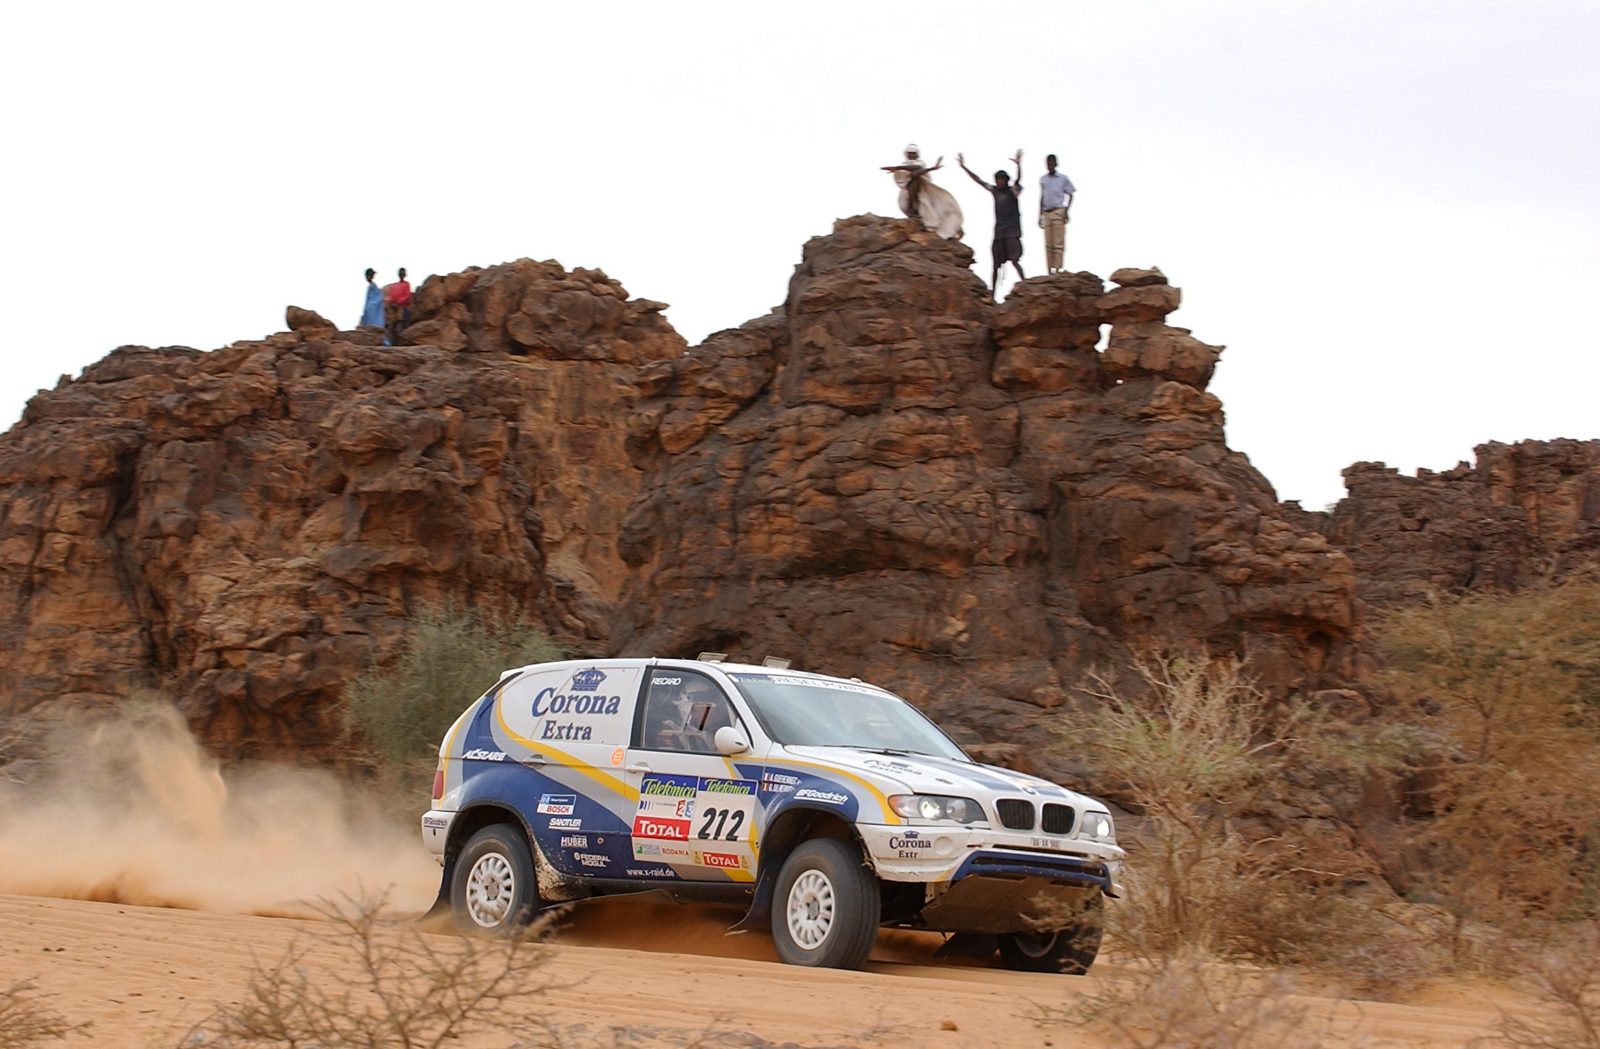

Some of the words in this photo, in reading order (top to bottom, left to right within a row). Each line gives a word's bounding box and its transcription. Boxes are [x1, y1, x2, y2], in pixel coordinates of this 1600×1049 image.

[652, 677, 682, 686] RECARO
[531, 687, 621, 717] Corona
[541, 720, 592, 740] Extra
[796, 788, 848, 803] BFGoodrich
[546, 806, 569, 814] BOSCH
[640, 820, 683, 837] TOTAL
[698, 807, 745, 841] 212
[561, 836, 588, 848] HUBER
[889, 837, 931, 849] Corona
[580, 853, 611, 862] FEDERAL
[662, 847, 689, 856] RODANIA
[704, 854, 739, 867] TOTAL
[626, 868, 675, 877] www.x-raid.de
